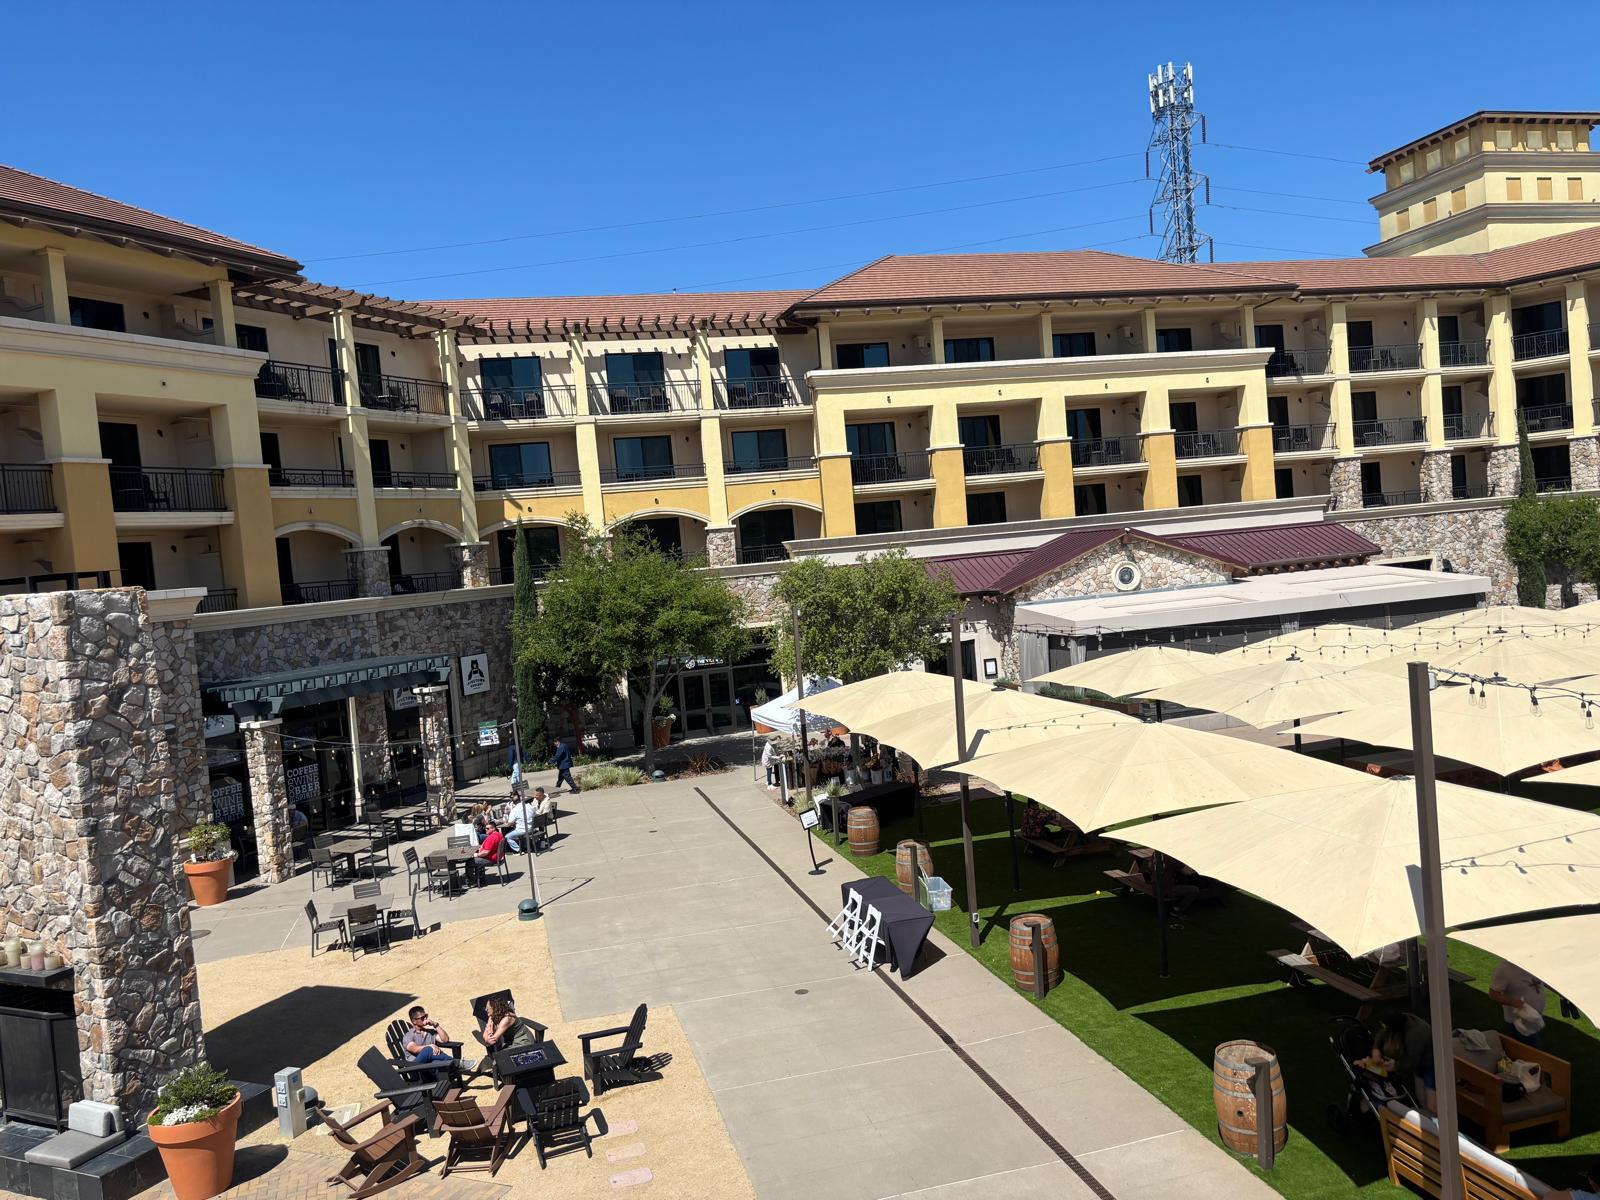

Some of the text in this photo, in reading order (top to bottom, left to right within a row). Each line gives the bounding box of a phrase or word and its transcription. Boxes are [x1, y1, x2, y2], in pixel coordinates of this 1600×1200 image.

[286, 763, 319, 778] COFFEE
[294, 772, 319, 786] WINE
[212, 783, 243, 798] OFFEE
[294, 781, 321, 795] BEER
[213, 793, 242, 809] WINE
[214, 803, 245, 818] BEER
